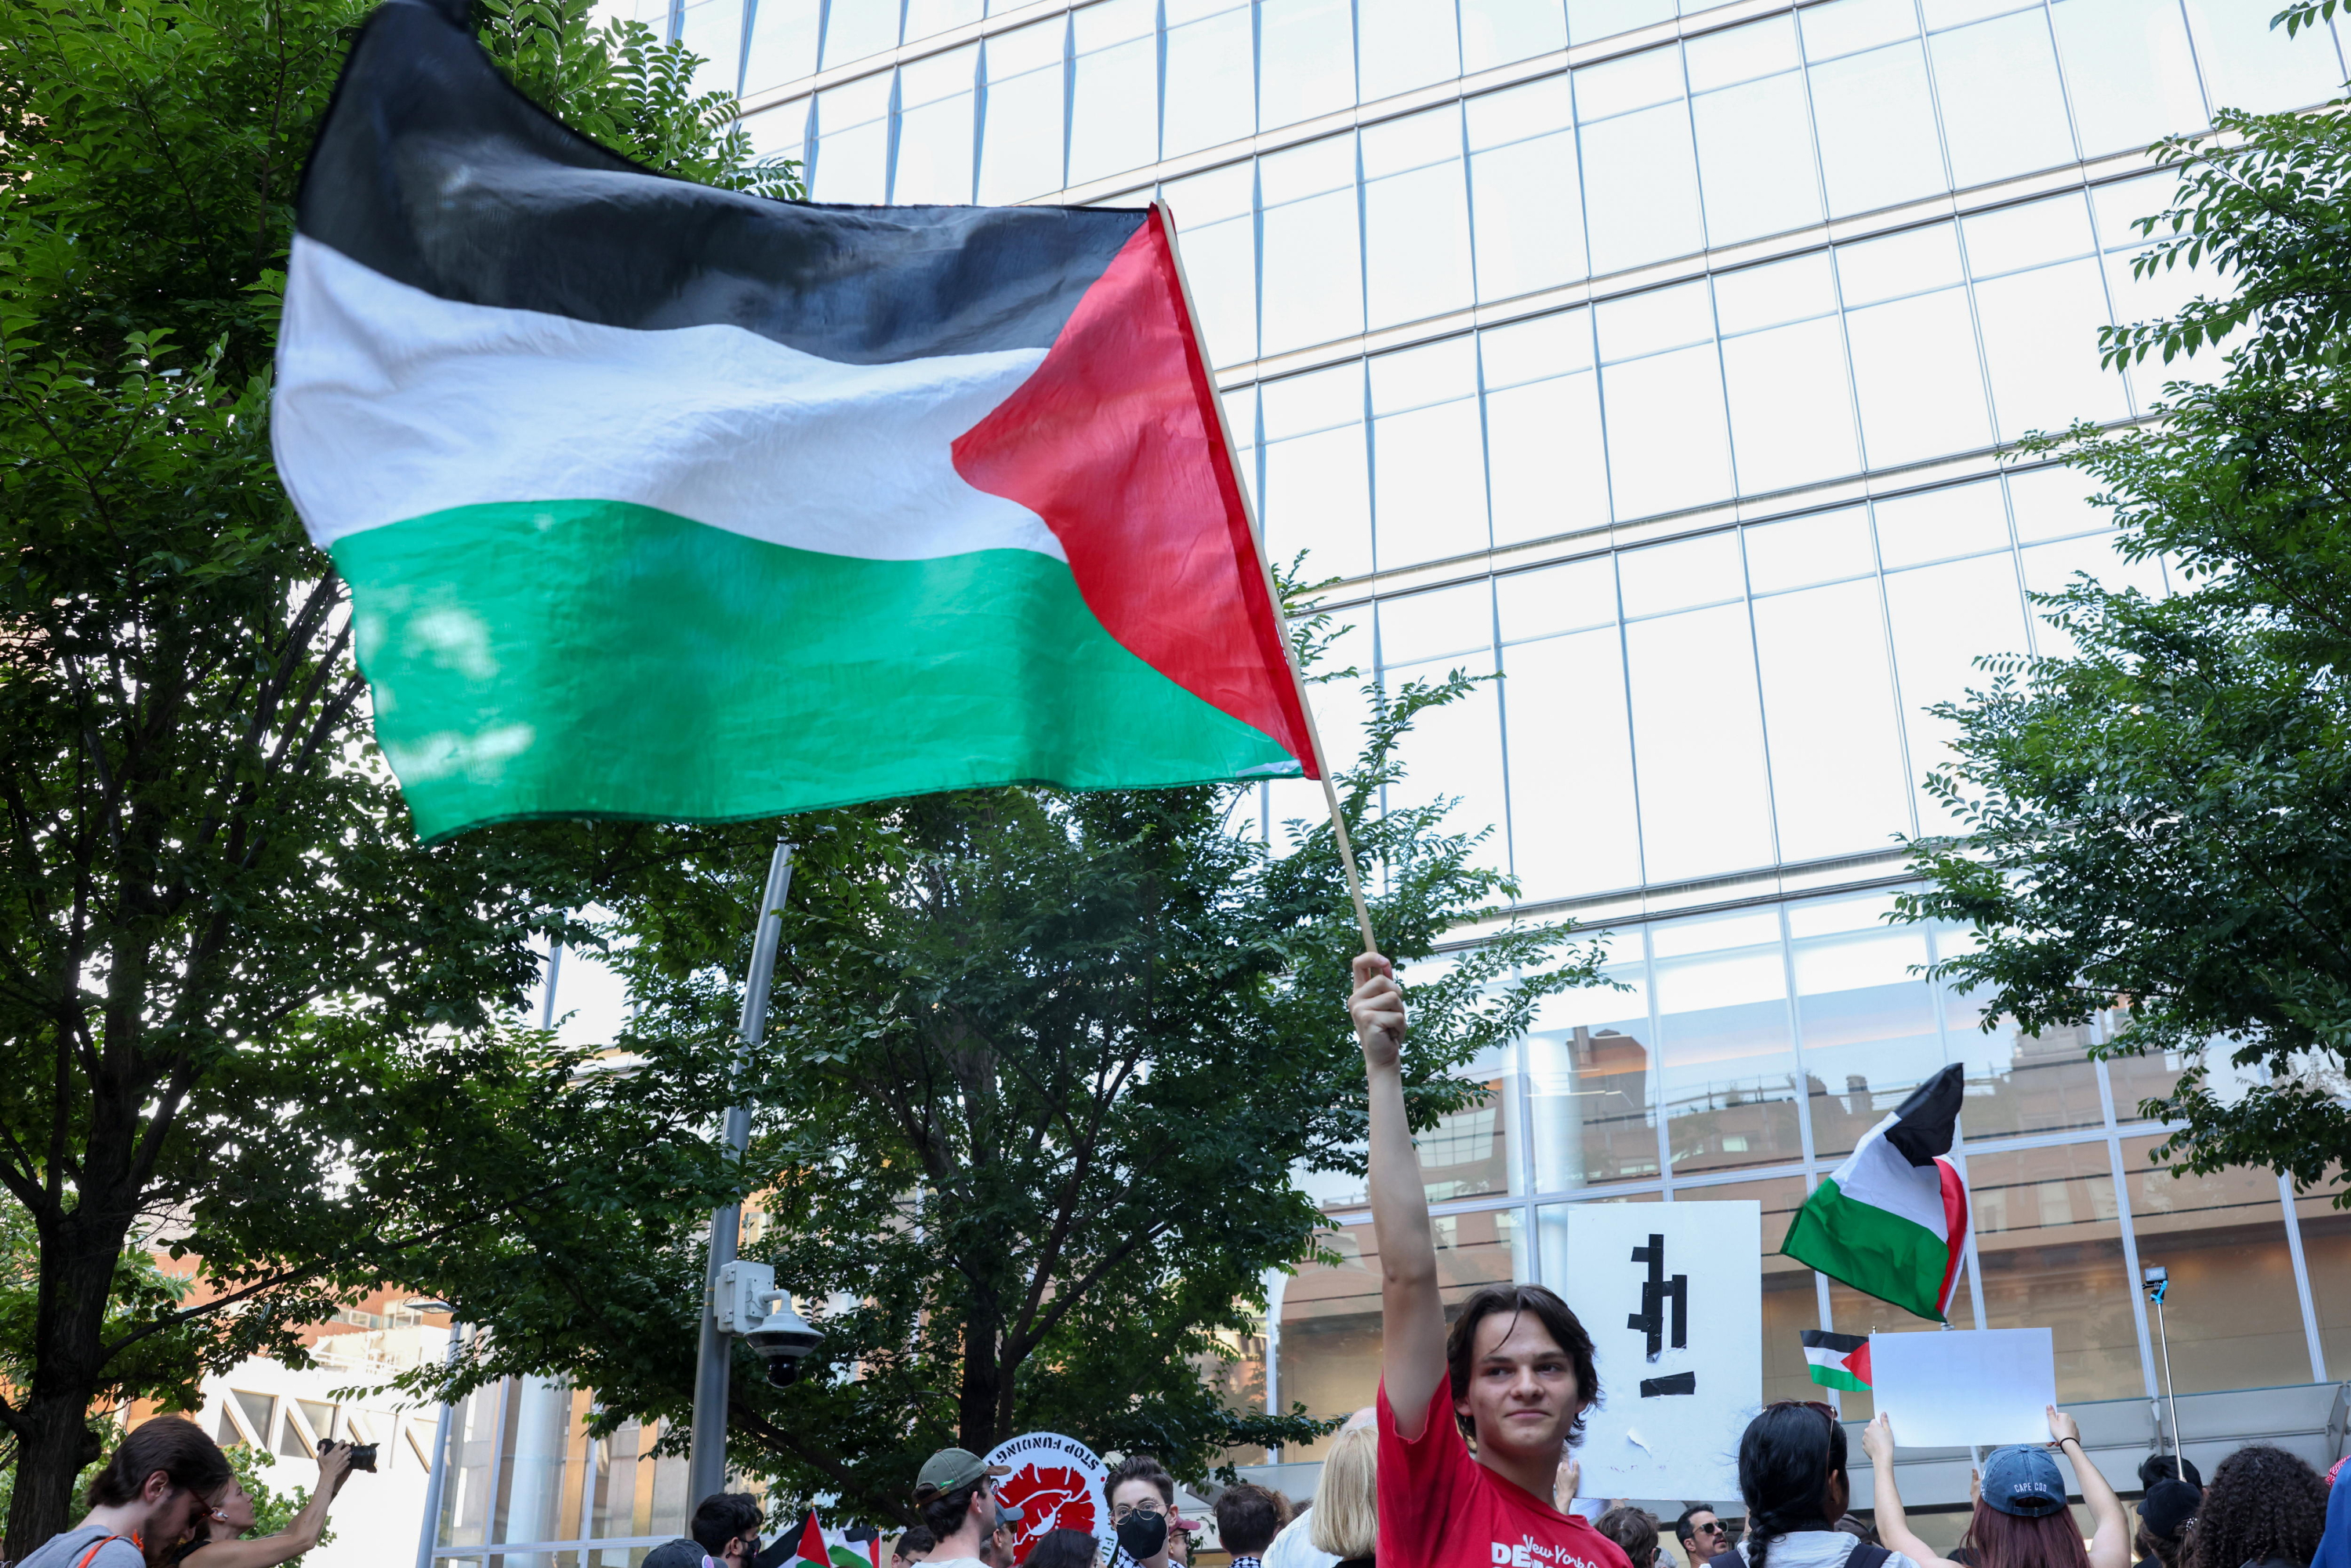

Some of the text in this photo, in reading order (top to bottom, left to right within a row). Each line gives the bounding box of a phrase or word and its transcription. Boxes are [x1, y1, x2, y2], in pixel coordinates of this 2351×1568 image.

[996, 1436, 1100, 1471] STOP FUNDING
[2014, 1483, 2047, 1493] CAPE COD
[1522, 1534, 1585, 1568] New York
